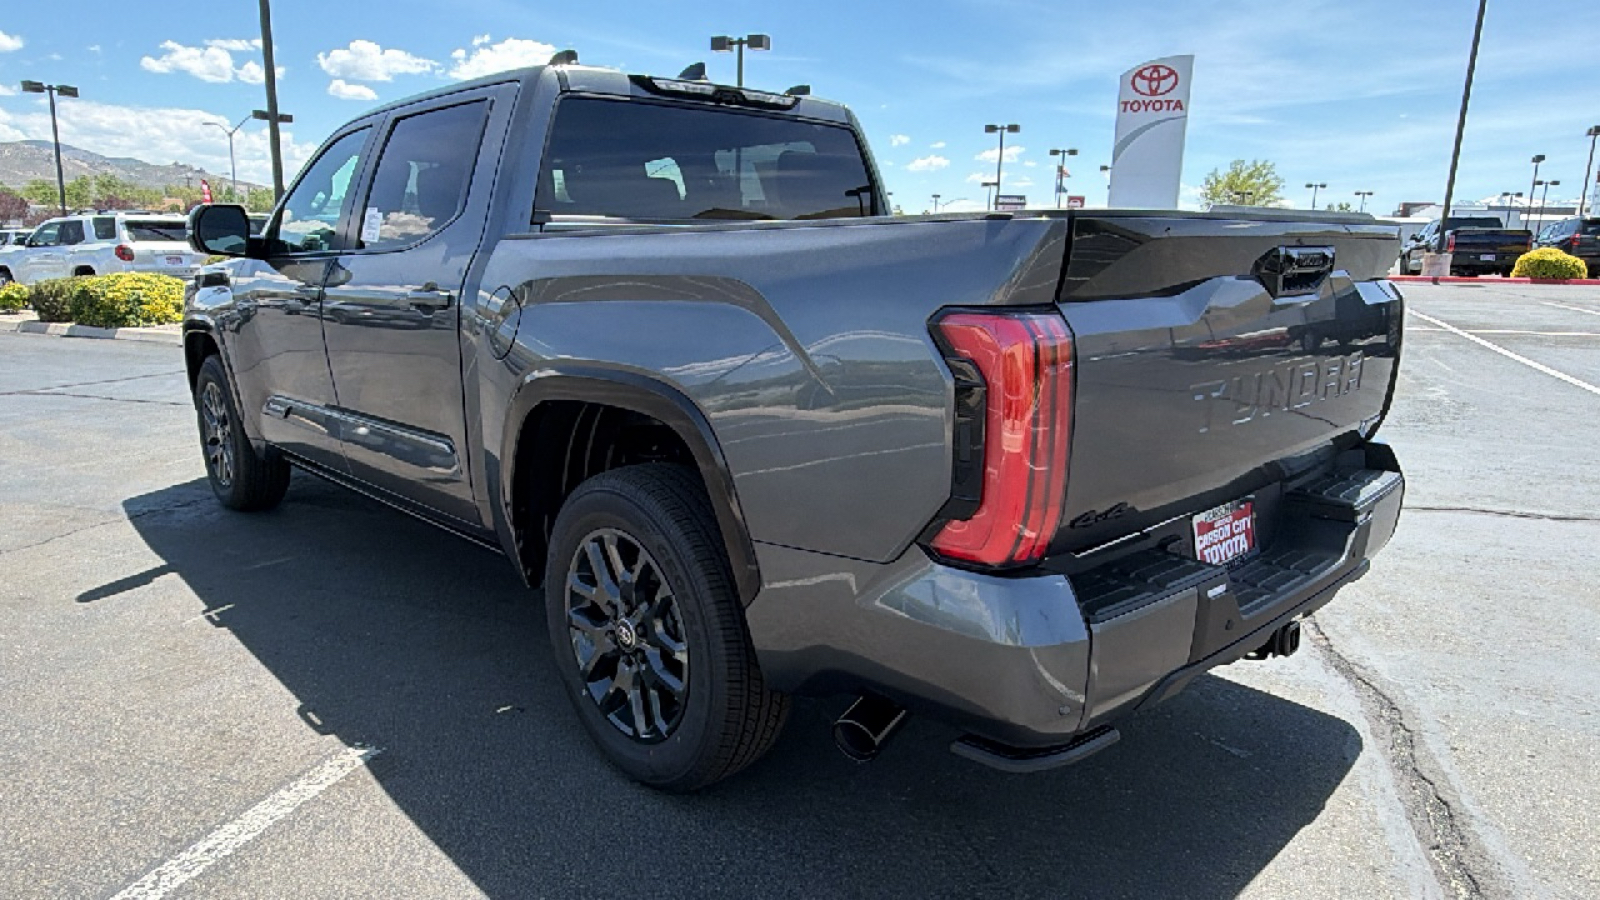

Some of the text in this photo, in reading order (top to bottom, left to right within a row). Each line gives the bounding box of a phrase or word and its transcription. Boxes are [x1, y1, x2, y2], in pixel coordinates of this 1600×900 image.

[1120, 99, 1184, 113] TOYOTA
[1190, 350, 1364, 434] TUNDRA
[1197, 523, 1231, 549] CARSON
[1232, 515, 1252, 534] CITY
[1203, 533, 1249, 565] TOYOTA
